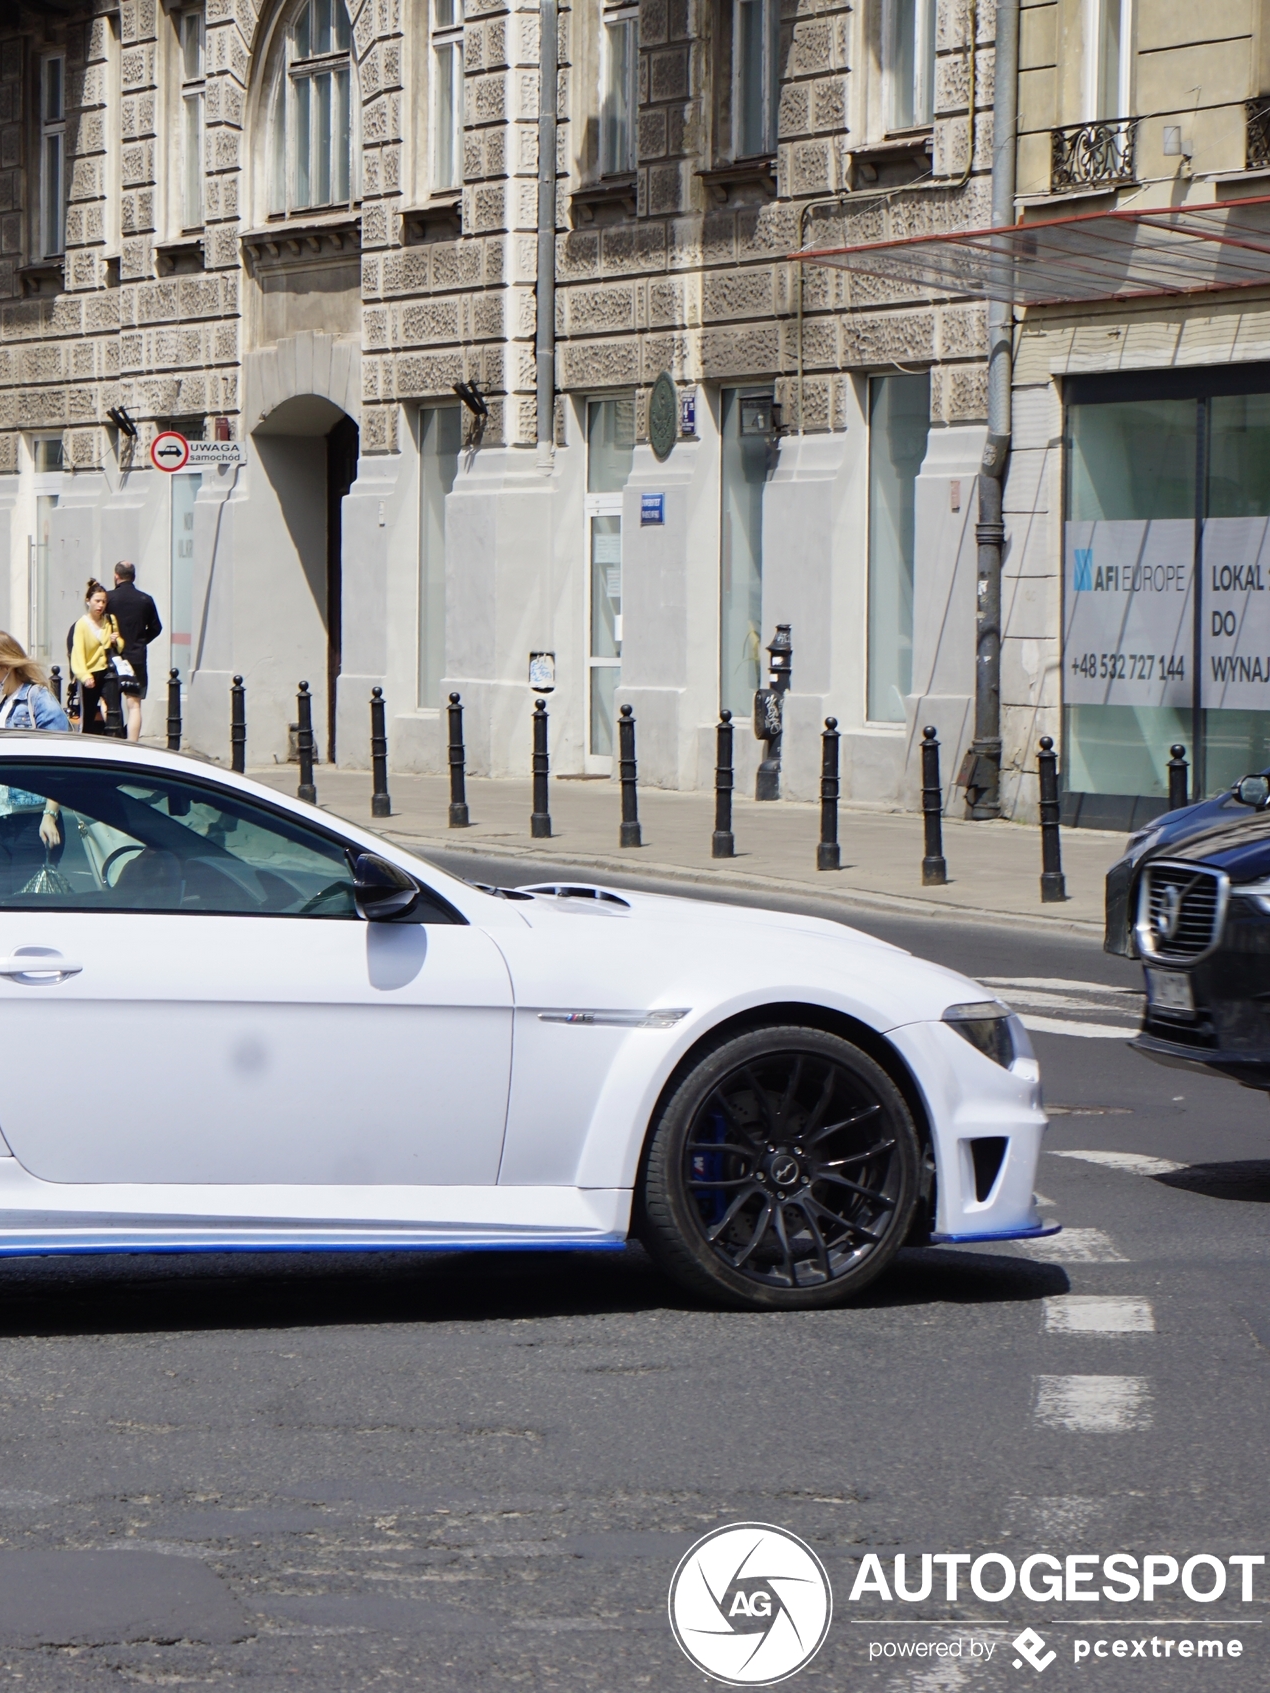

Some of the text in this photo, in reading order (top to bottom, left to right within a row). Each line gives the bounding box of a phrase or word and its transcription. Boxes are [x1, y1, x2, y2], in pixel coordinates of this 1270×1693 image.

[190, 444, 240, 452] UWAGA
[190, 453, 241, 461] samochód
[1094, 565, 1186, 592] AFI EUROPE
[1212, 565, 1265, 592] LOKAL
[1212, 610, 1236, 637] DO
[1071, 653, 1185, 682] +48 532 727 144
